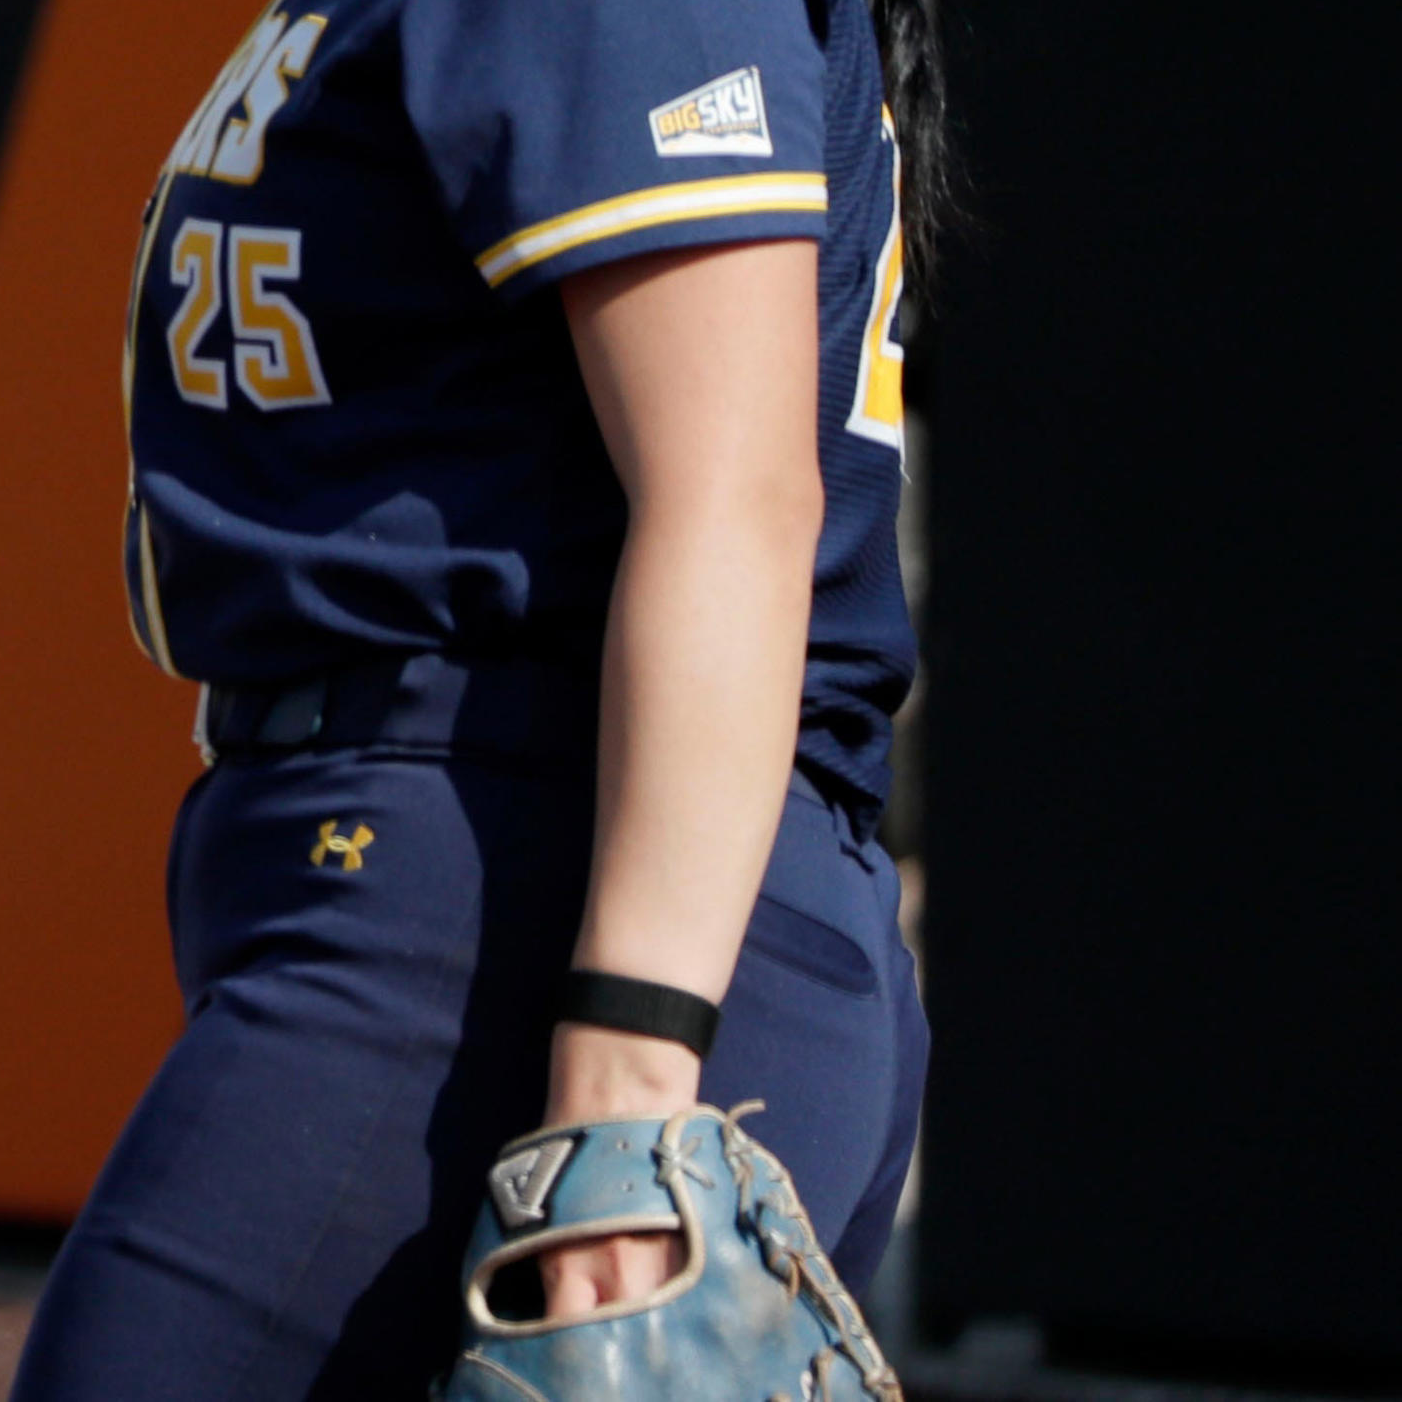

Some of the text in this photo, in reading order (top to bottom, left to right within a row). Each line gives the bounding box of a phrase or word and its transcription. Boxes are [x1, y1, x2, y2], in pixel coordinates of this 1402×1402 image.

[657, 76, 759, 138] BIG SKY
[166, 217, 333, 412] 25
